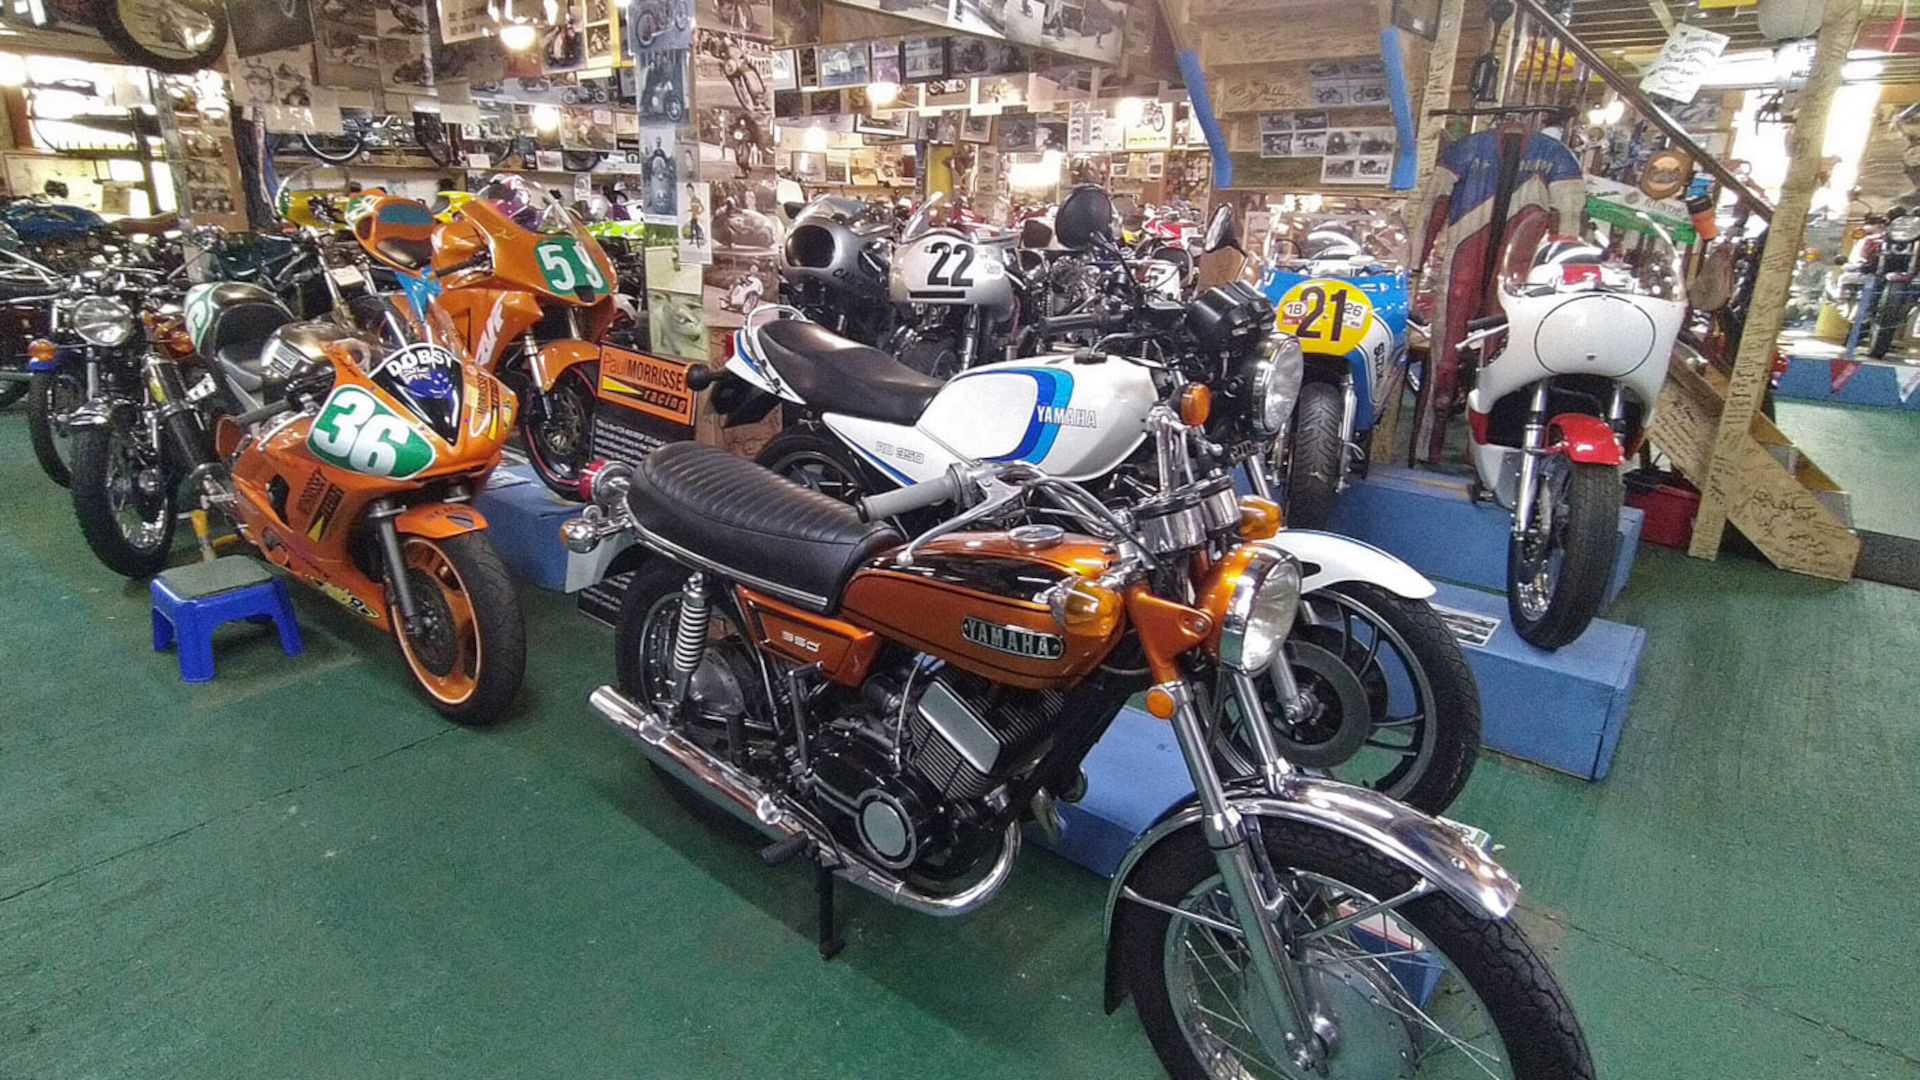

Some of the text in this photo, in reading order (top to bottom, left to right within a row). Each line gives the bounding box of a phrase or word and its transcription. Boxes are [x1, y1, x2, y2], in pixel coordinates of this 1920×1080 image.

[926, 241, 974, 288] 22
[1286, 303, 1303, 315] 18
[1295, 286, 1348, 342] 21
[1345, 302, 1363, 317] 26
[385, 348, 452, 377] DOBSY
[603, 352, 626, 375] Paul
[643, 389, 687, 413] racing
[1036, 404, 1098, 428] YAMAHA
[312, 390, 410, 477] 36
[895, 447, 925, 465] 350
[780, 629, 821, 653] 350
[966, 619, 1050, 657] YAMAHA
